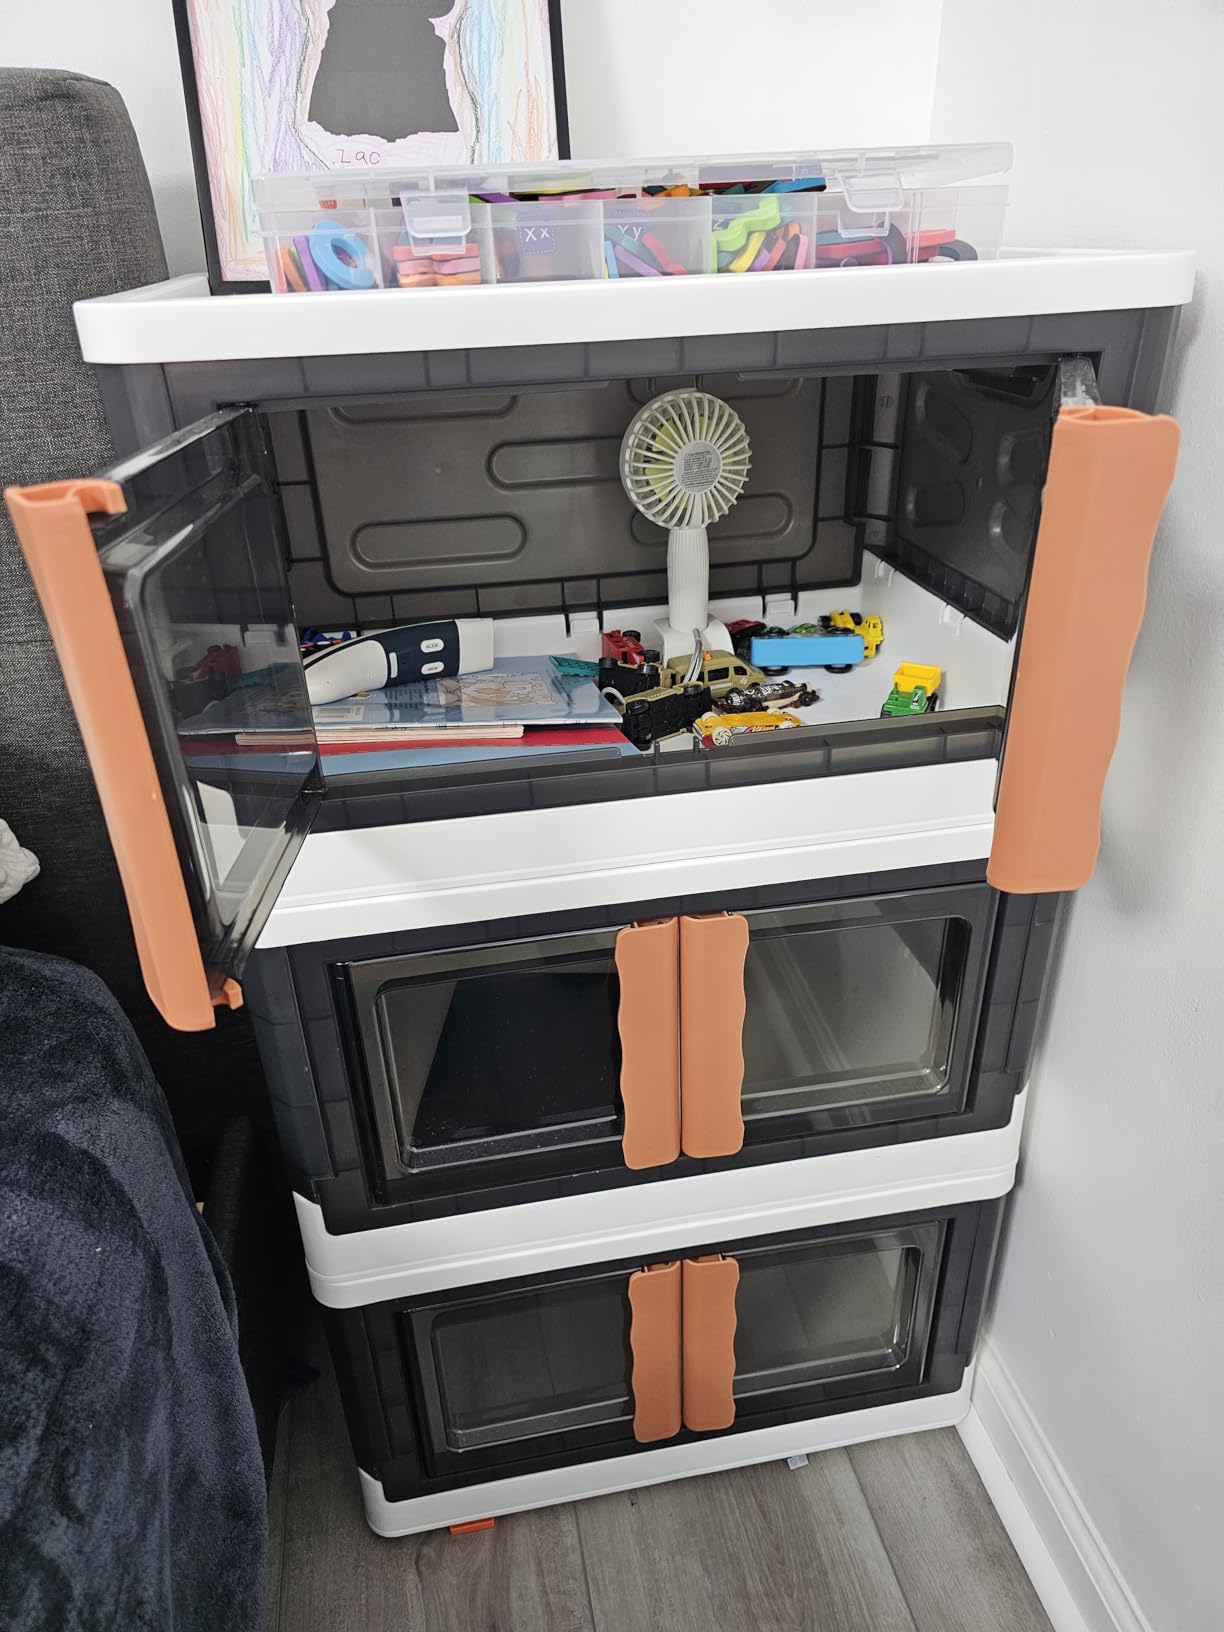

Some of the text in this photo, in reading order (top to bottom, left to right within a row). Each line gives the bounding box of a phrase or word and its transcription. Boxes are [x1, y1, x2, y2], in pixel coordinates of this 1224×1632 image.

[335, 148, 381, 165] Zac
[524, 227, 537, 242] X
[633, 225, 642, 241] y
